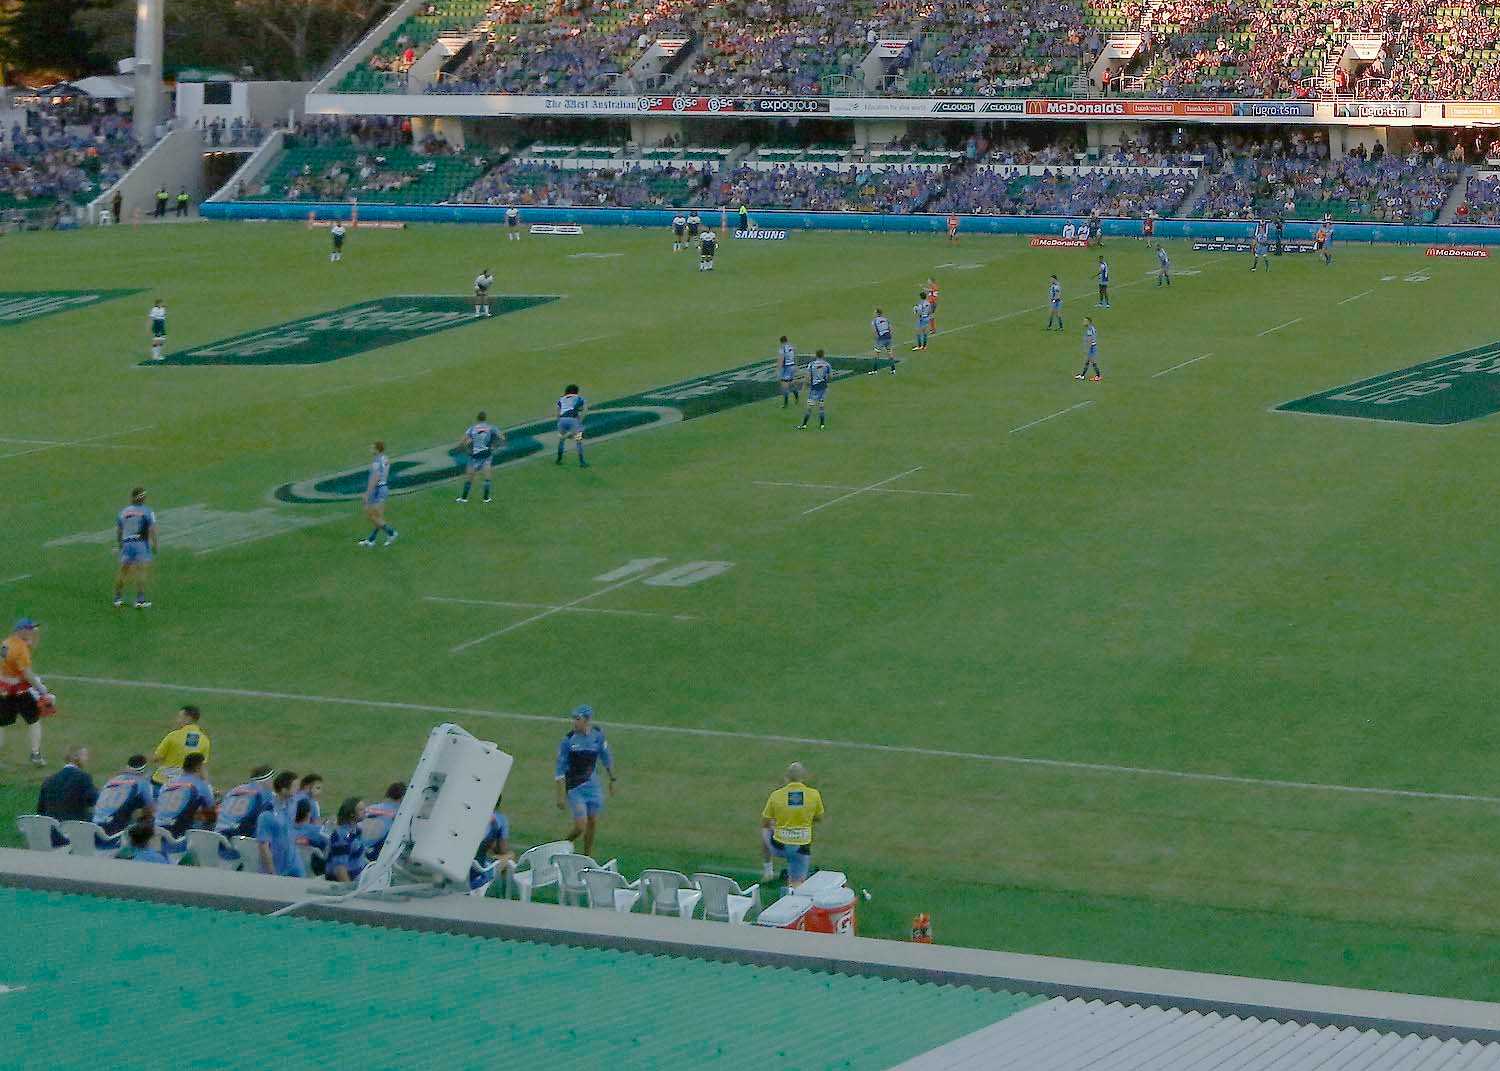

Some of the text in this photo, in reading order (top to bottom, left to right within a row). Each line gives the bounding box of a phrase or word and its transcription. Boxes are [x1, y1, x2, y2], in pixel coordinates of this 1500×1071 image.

[592, 99, 638, 109] Australian
[760, 100, 818, 112] expogroup
[942, 103, 974, 112] CLOUGH
[990, 104, 1022, 112] CLOUGH
[1047, 103, 1124, 114] McDonald's
[735, 230, 785, 239] SAMSUNG
